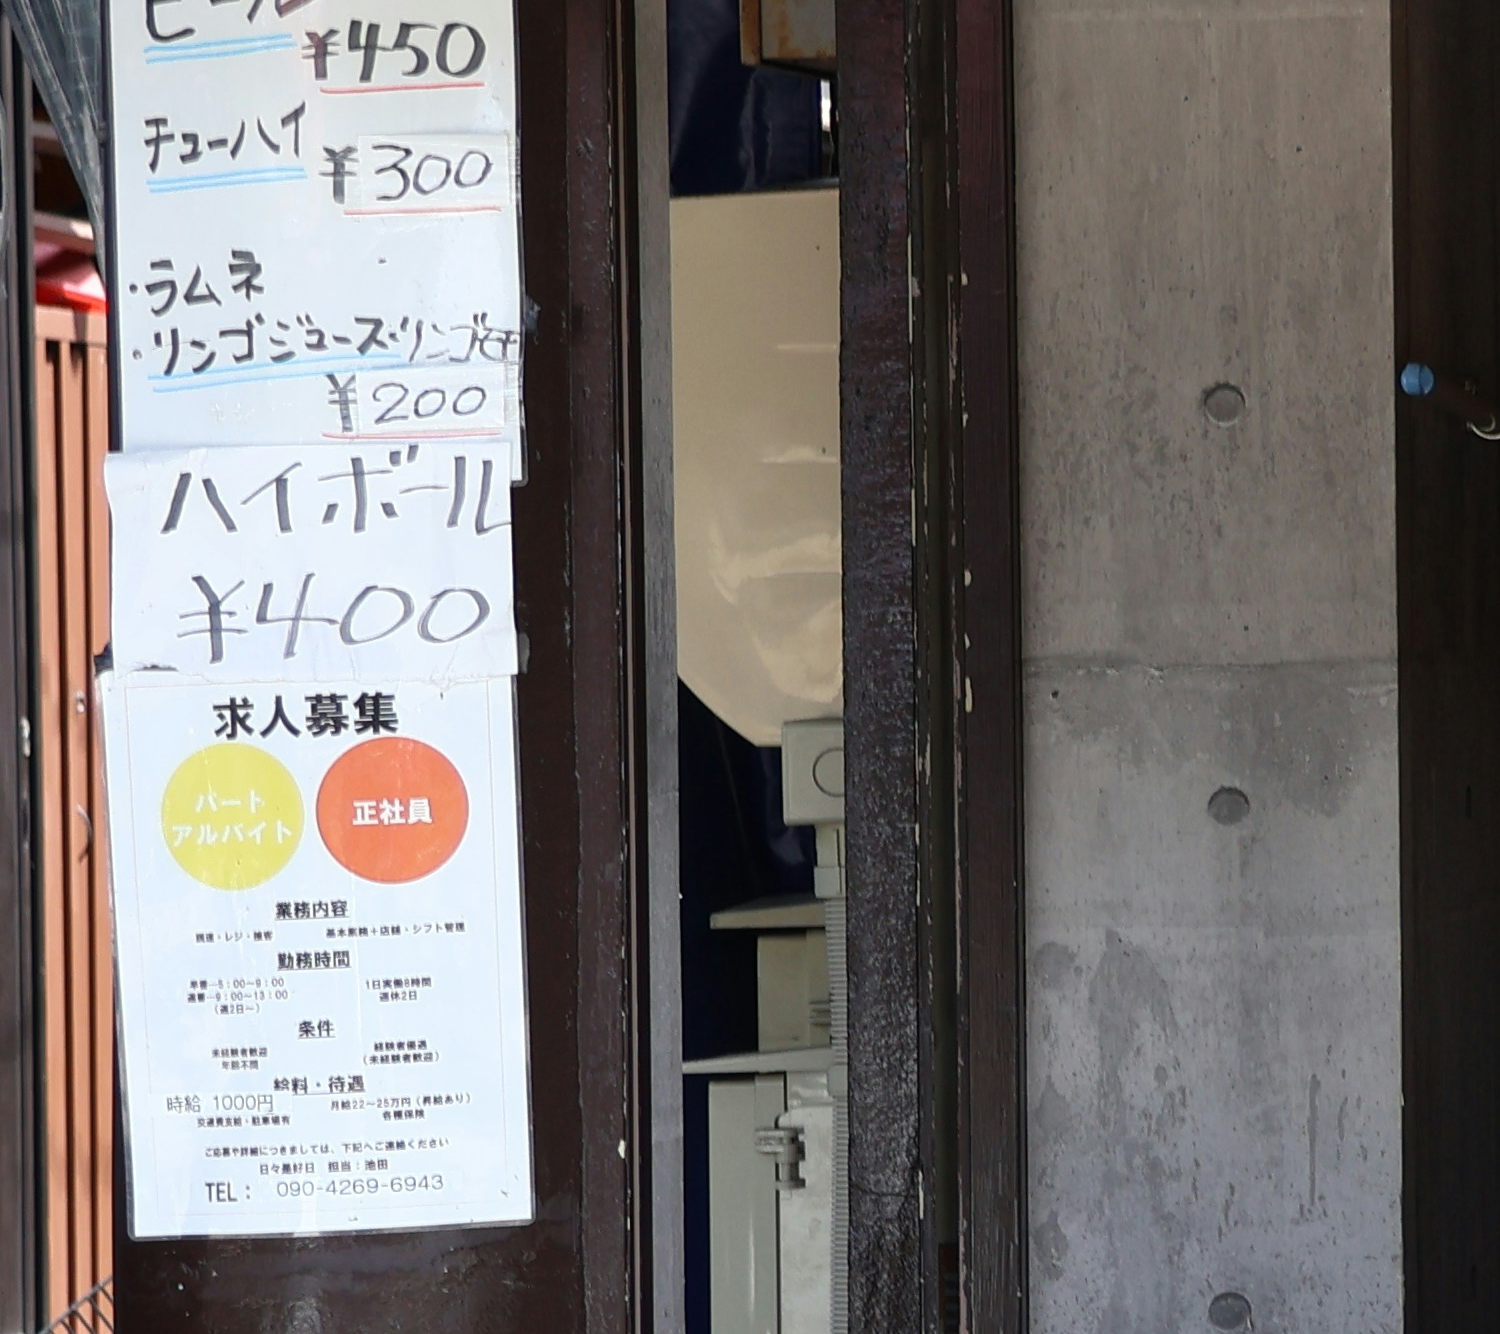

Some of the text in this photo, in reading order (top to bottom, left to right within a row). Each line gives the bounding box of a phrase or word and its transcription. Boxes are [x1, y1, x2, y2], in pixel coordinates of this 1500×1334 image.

[301, 20, 487, 83] ¥450
[144, 101, 306, 174] チューハイ
[319, 143, 495, 204] ¥300
[326, 372, 488, 434] ¥200
[160, 445, 512, 536] ハイボール
[177, 573, 491, 664] ¥400
[212, 691, 399, 741] 求人募集
[195, 789, 265, 815] パート
[351, 797, 433, 826] 正社員
[171, 819, 293, 848] アルバイト
[274, 899, 350, 919] 業務内容
[277, 950, 351, 970] 勤務時間
[298, 1019, 336, 1038] 条件
[273, 1075, 366, 1094] 給料・待遇
[166, 1094, 275, 1114] 時給 1000円
[382, 1108, 426, 1122] 各種保険
[259, 1161, 315, 1176] 日々是好日
[276, 1174, 444, 1198] 090-4269-6943
